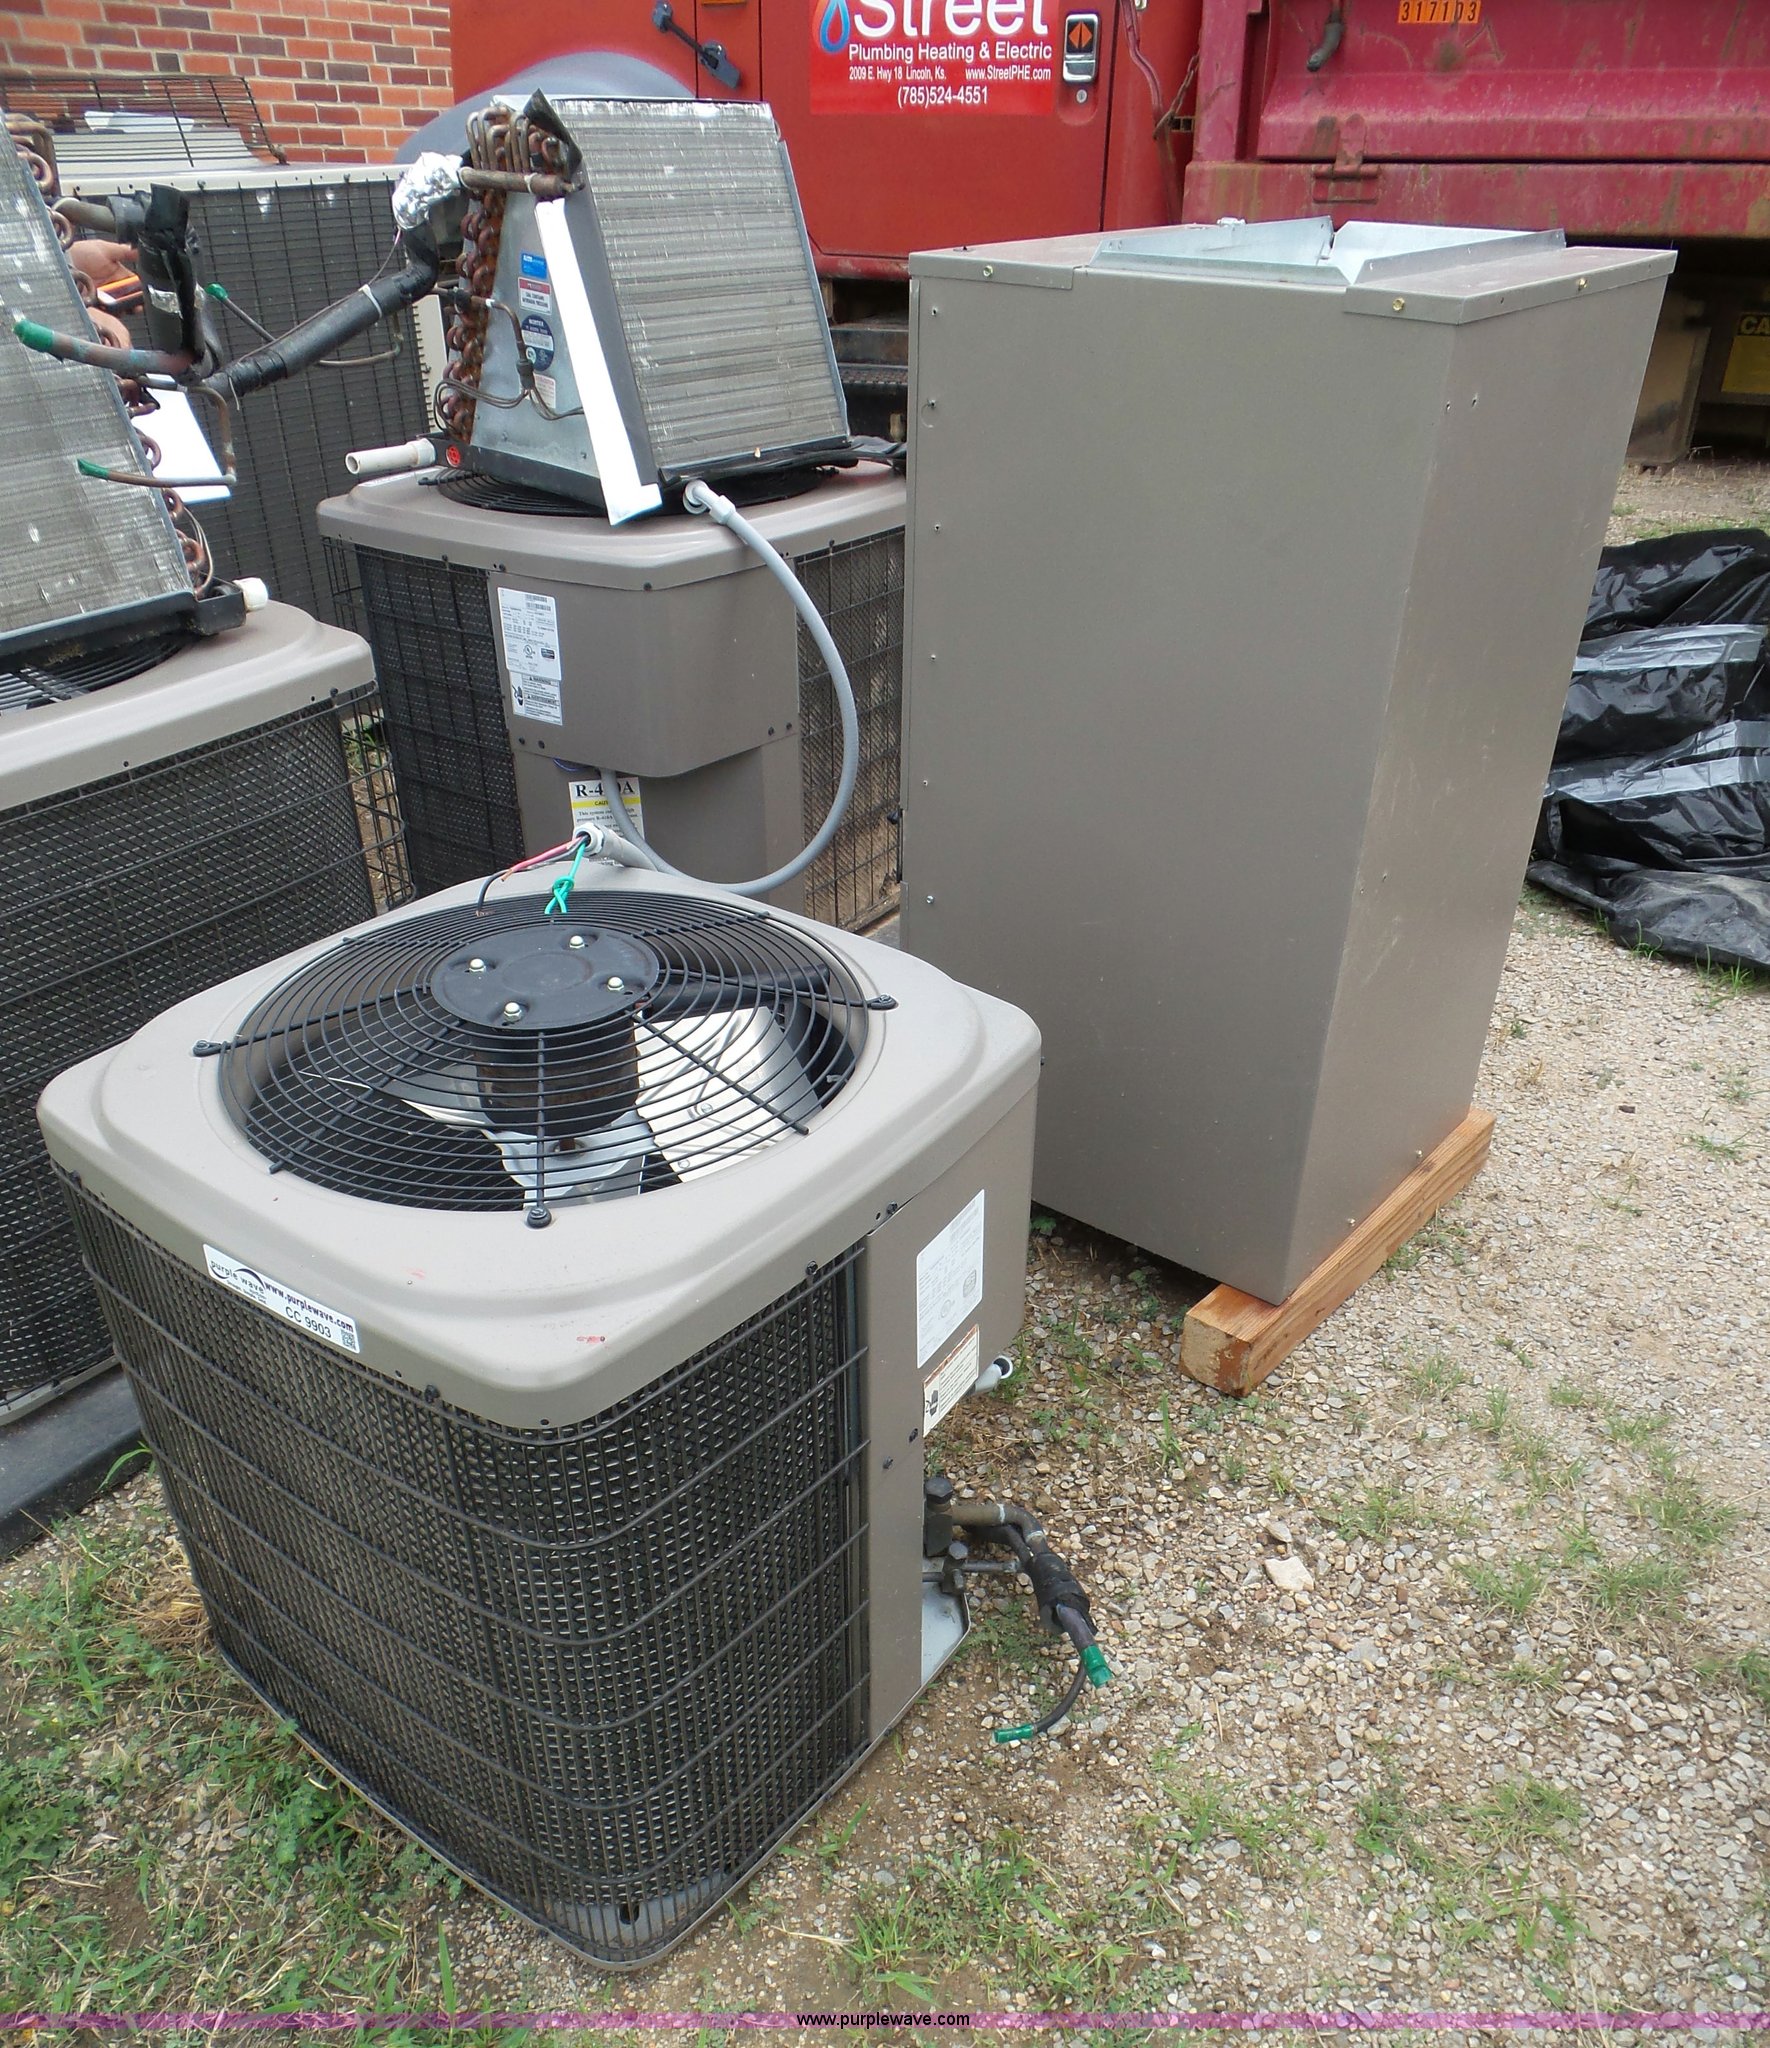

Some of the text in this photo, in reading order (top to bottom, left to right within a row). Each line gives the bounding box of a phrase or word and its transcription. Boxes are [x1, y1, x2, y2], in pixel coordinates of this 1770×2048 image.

[853, 0, 1049, 37] Street
[1401, 1, 1477, 21] 317103
[849, 41, 1053, 62] Plumbing Heating & Electric
[849, 65, 1051, 83] 2009 E. Hwy 18 Lincoln, Ks. www.StreetPHE.com
[897, 86, 988, 108] (785)524-4551
[575, 781, 635, 797] R-4A
[210, 1260, 238, 1281] purple
[240, 1277, 265, 1294] wave
[264, 1281, 354, 1333] www.purplewave.com
[286, 1306, 332, 1339] CC 9903
